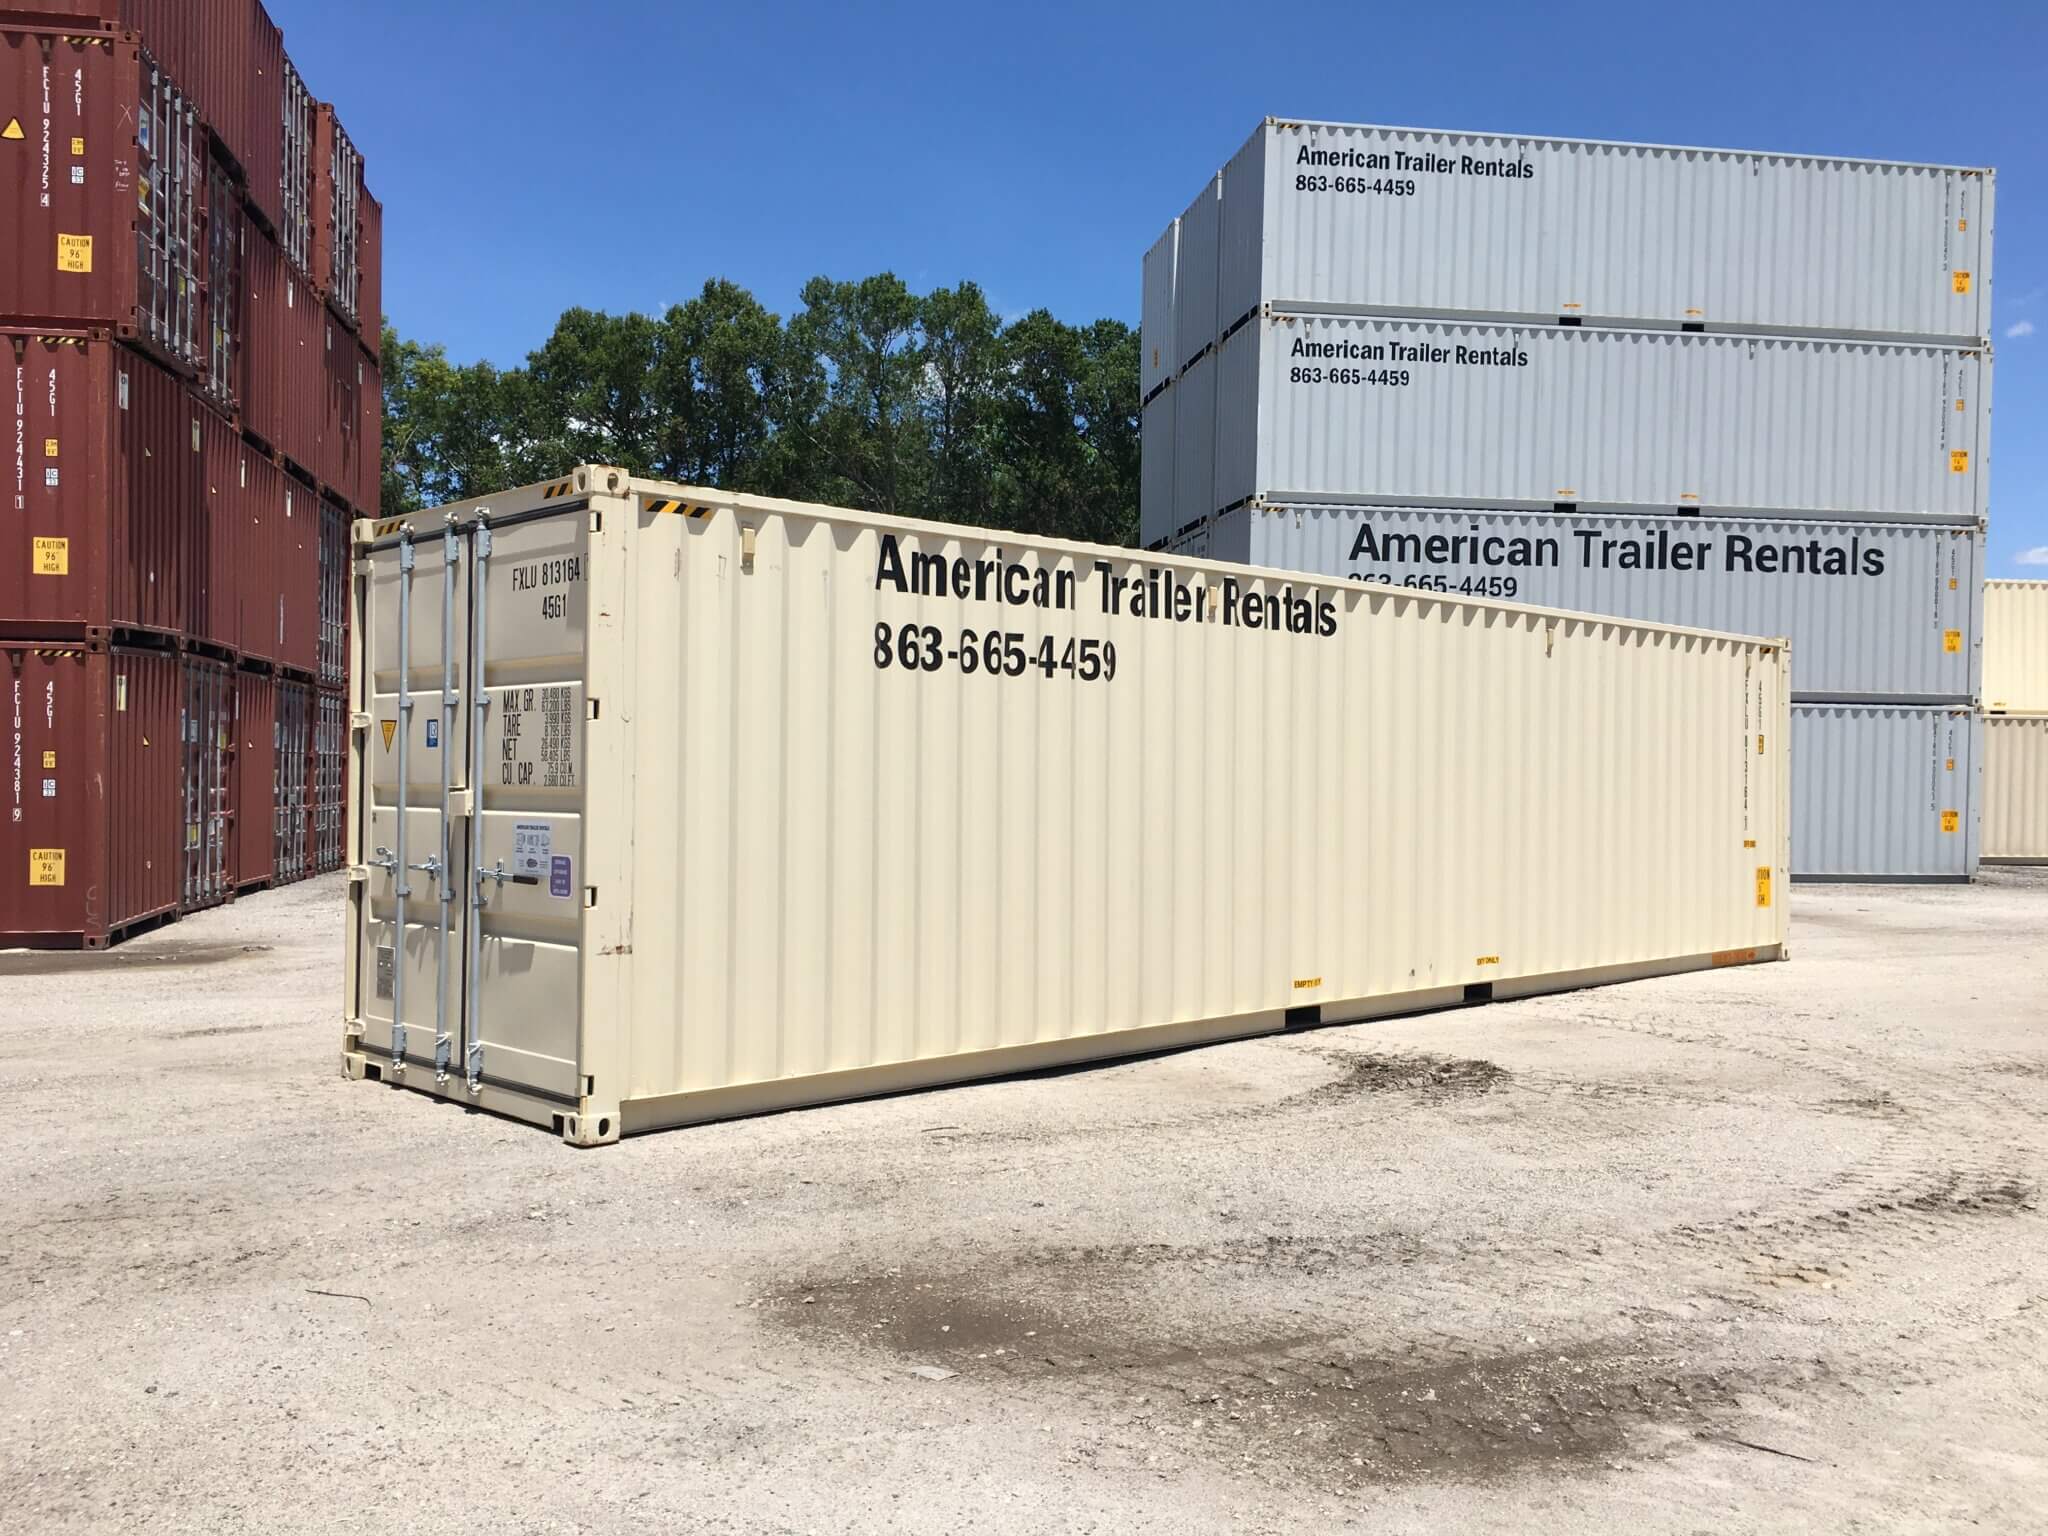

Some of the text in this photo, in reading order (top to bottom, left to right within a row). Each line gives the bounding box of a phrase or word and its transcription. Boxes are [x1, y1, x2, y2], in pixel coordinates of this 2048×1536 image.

[74, 68, 82, 116] 45G1
[42, 119, 50, 189] 924325
[1296, 145, 1534, 179] American Trailer Rentals
[1295, 174, 1415, 196] 863-665-4459
[60, 237, 90, 247] CAUTION
[67, 260, 84, 269] HIGH
[1291, 337, 1528, 367] American Trailer Rentals
[1290, 366, 1410, 386] 863-665-4459
[48, 368, 56, 416] 45G1
[35, 540, 66, 550] CAUTION
[1348, 523, 1886, 577] American Trailer Rentals
[43, 563, 60, 571] HIGH
[512, 565, 537, 591] FXLU
[542, 557, 580, 586] 813164
[874, 533, 1337, 636] American Trailer Rentals
[542, 594, 567, 620] 45G1
[874, 621, 1117, 682] 863-665-4459
[46, 681, 54, 729] 45G1
[502, 714, 522, 736] TARE
[502, 738, 518, 760] NET
[33, 851, 62, 860] CAUTION
[40, 874, 56, 882] HIGH
